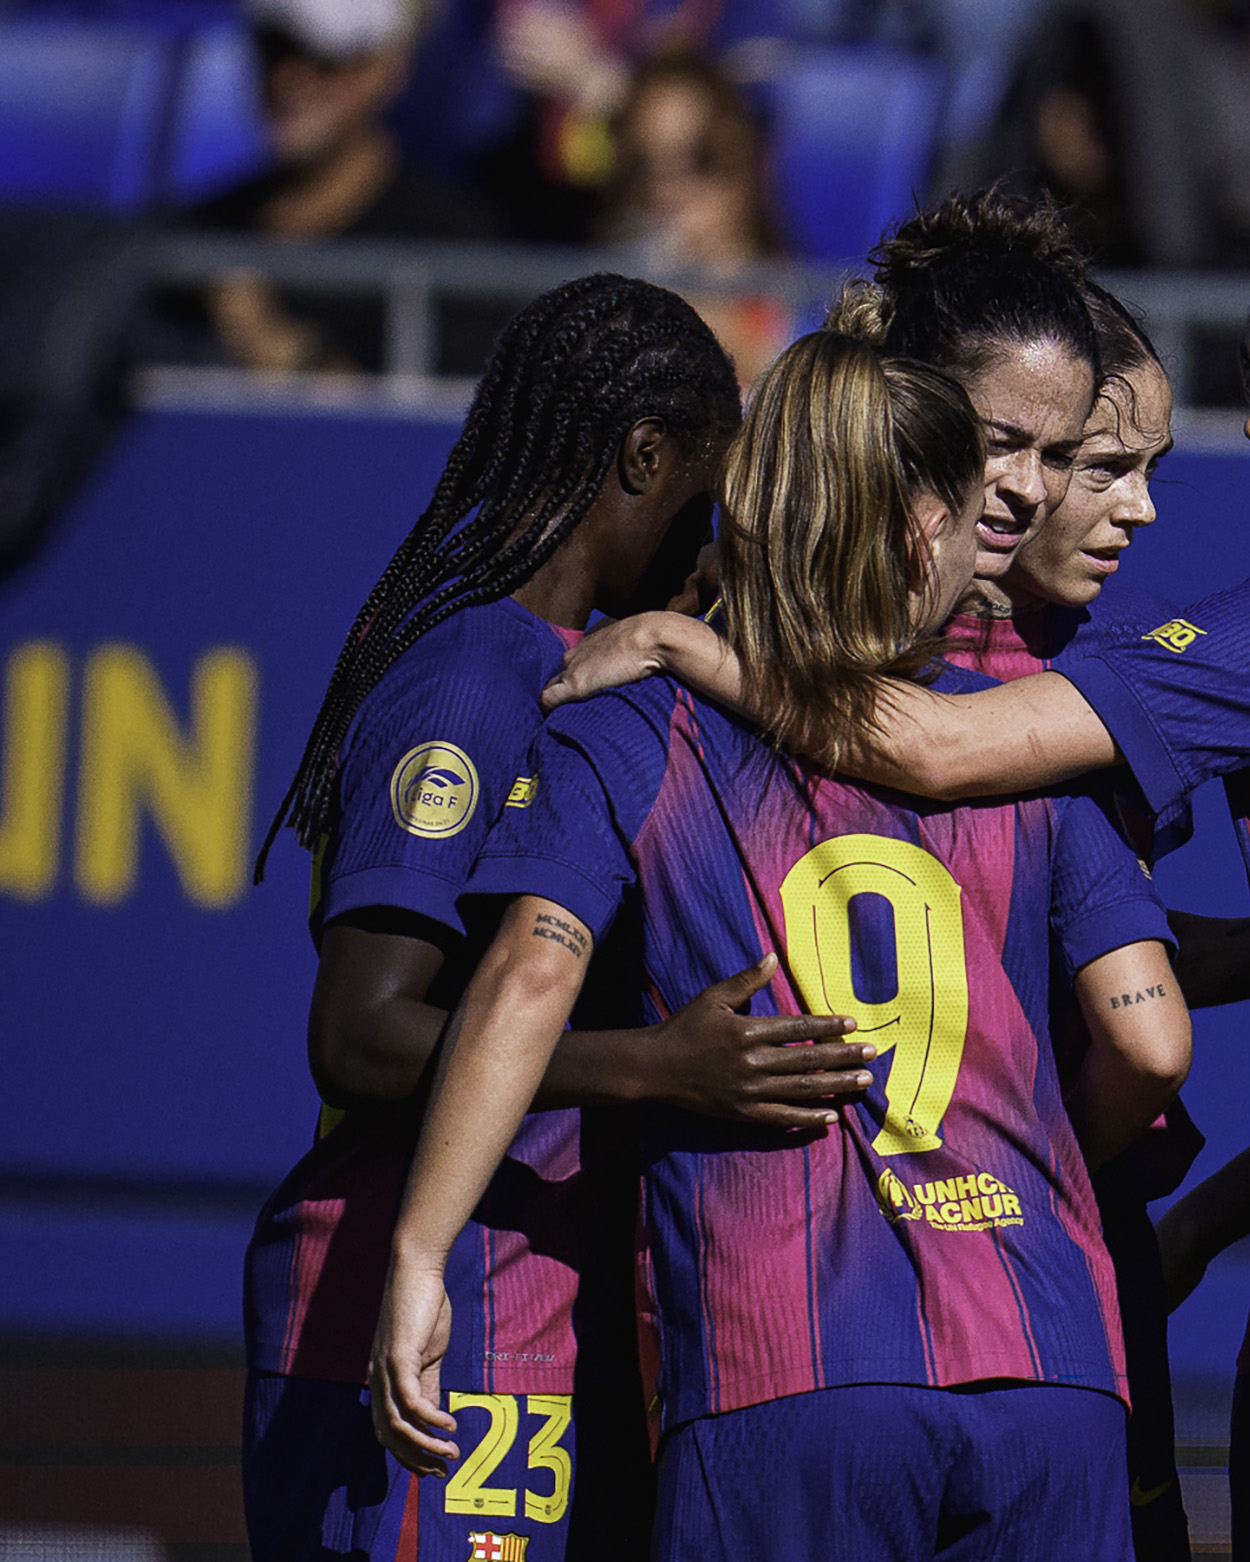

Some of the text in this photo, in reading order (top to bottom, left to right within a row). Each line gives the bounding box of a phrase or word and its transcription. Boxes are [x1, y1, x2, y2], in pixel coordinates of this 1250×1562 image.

[447, 796, 458, 808] F
[779, 833, 969, 1156] 9
[1109, 983, 1167, 1010] BRAVE
[925, 1193, 1023, 1224] ACNUR
[445, 1392, 573, 1523] 23
